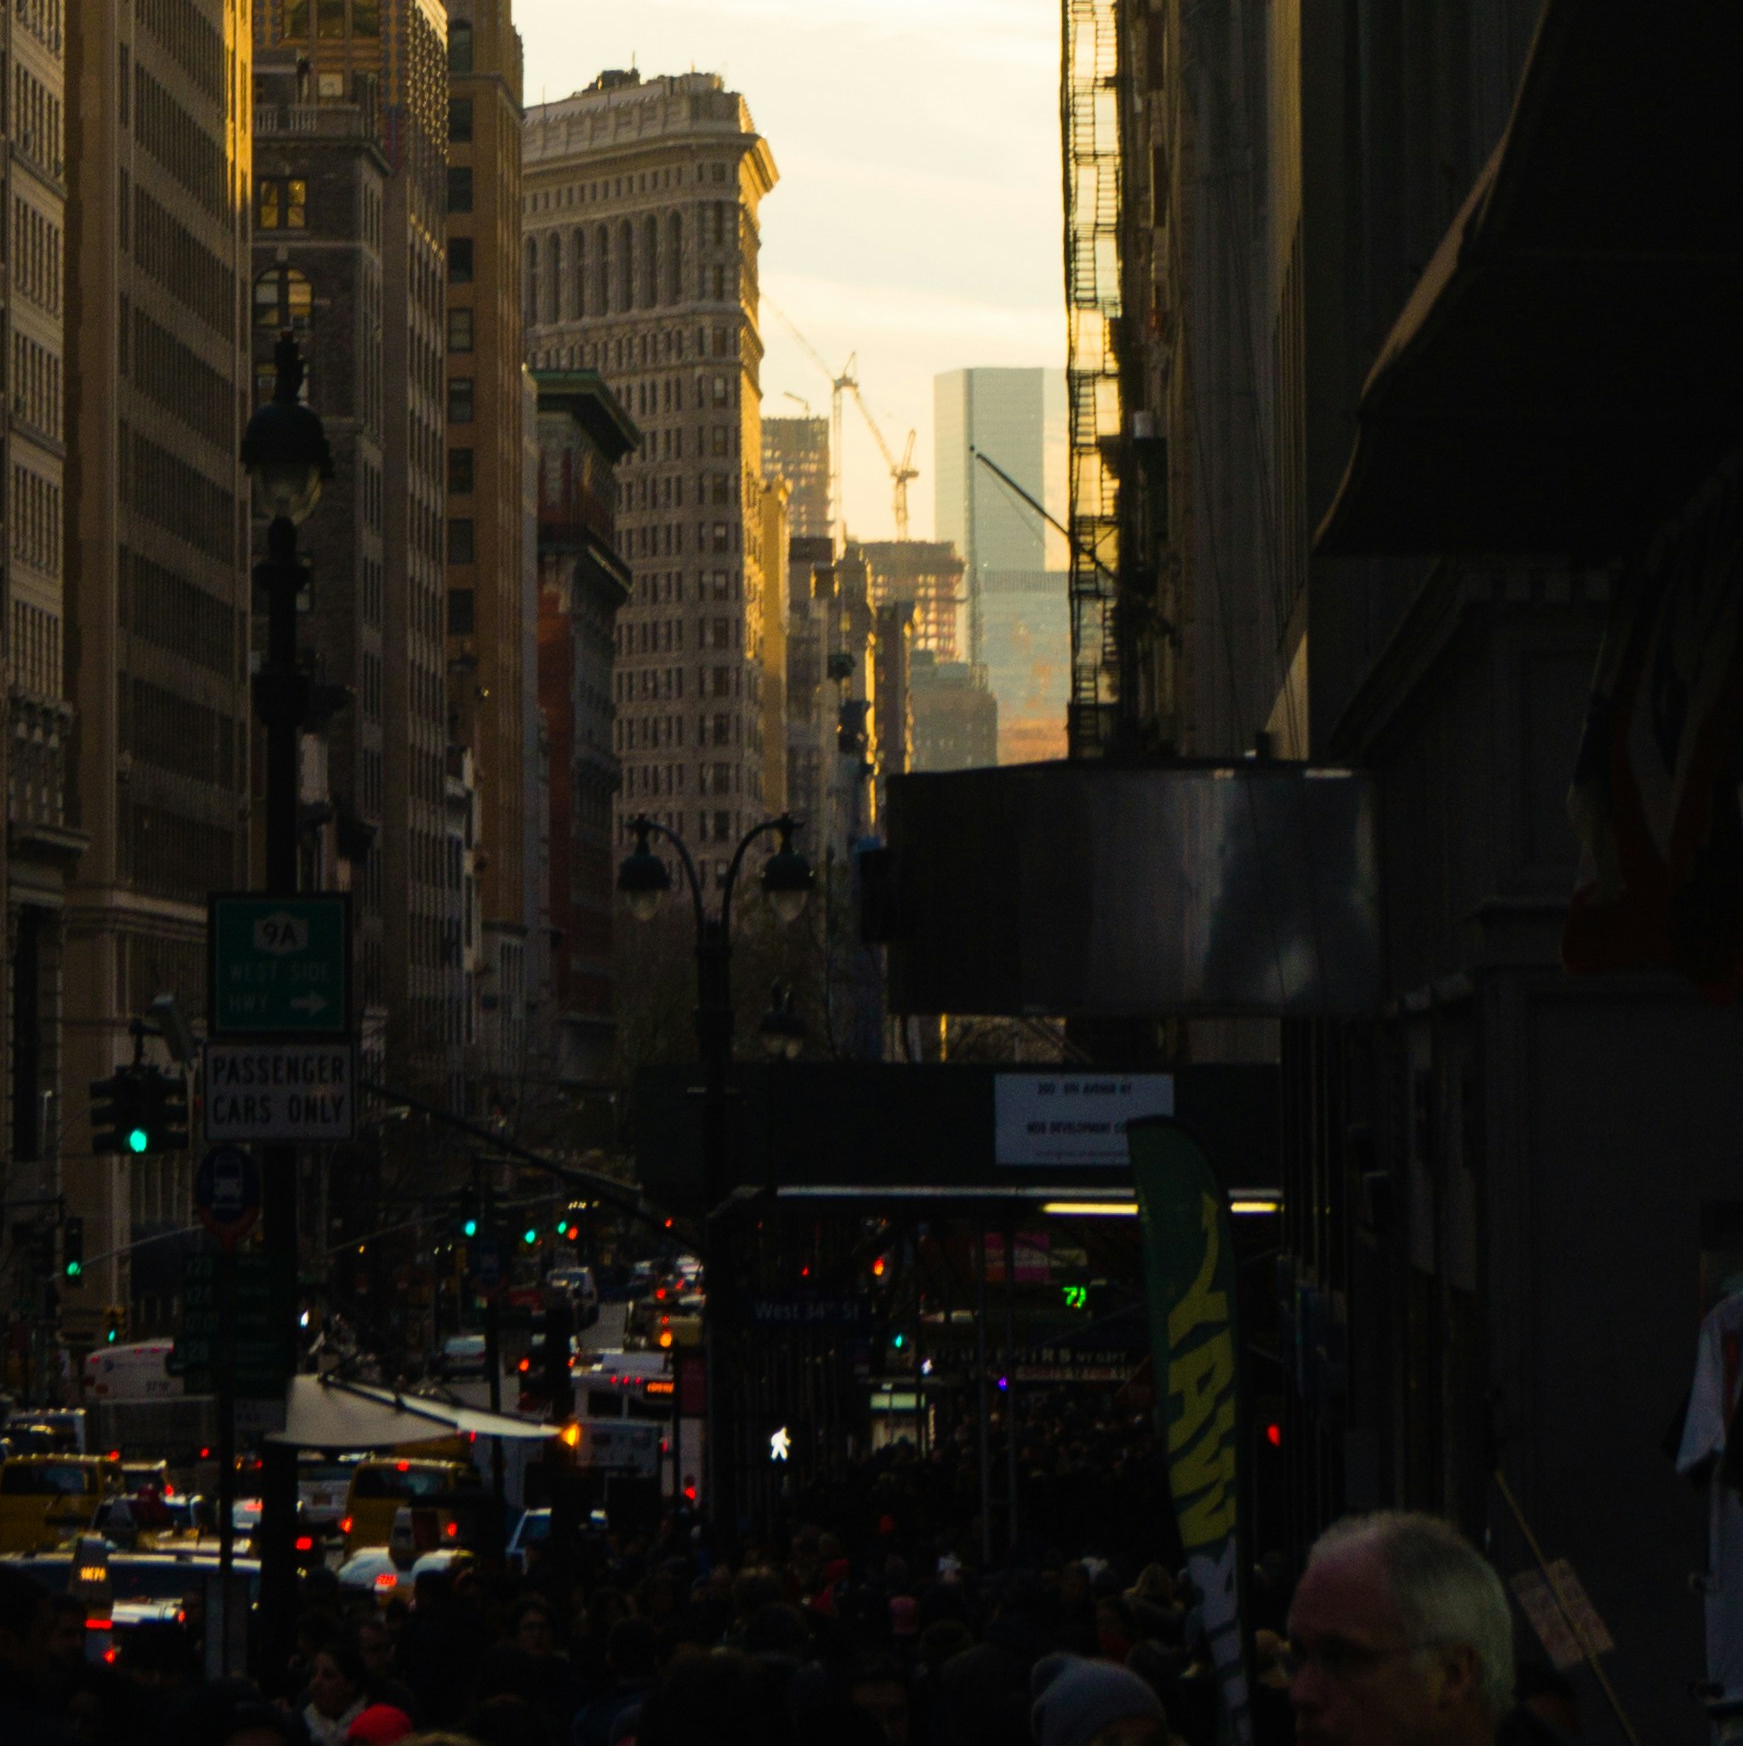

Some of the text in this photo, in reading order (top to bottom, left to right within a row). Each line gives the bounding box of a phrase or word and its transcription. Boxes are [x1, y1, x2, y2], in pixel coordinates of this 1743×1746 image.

[262, 921, 298, 947] 9A
[229, 961, 331, 984] WEST SIDE
[228, 992, 270, 1014] HWY
[212, 1055, 345, 1086] PASSENGER
[212, 1096, 345, 1125] CARS ONLY
[753, 1299, 799, 1321] West
[842, 1300, 860, 1322] St
